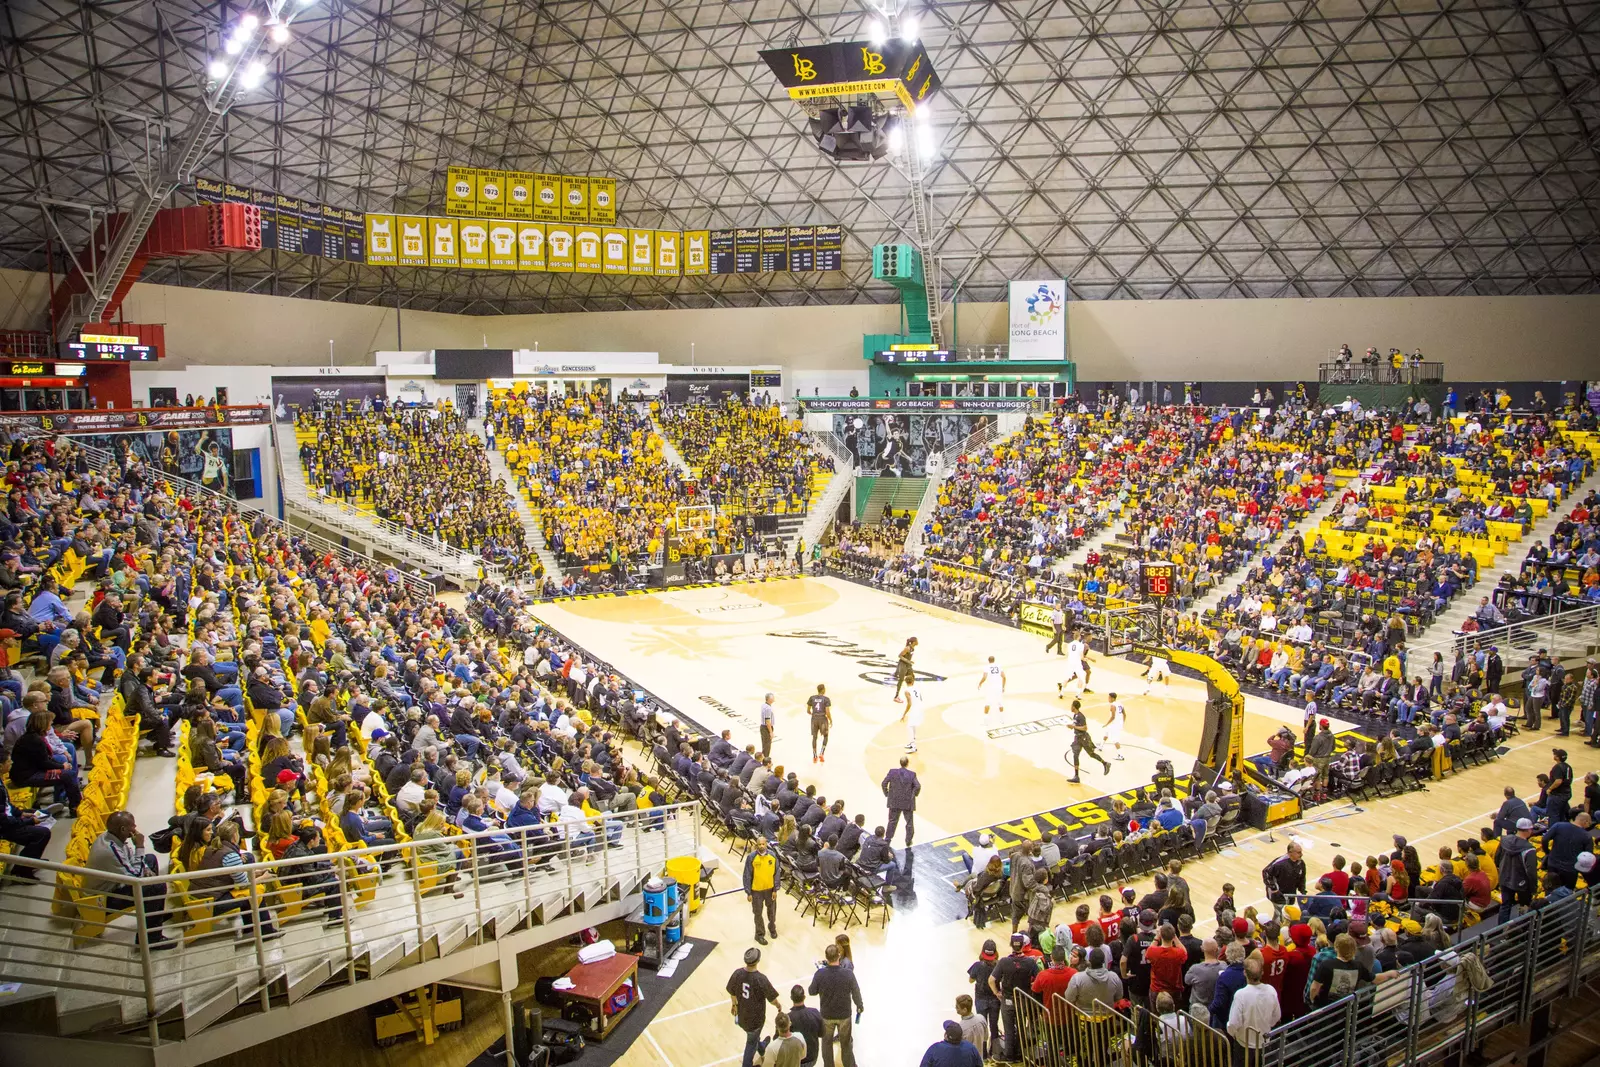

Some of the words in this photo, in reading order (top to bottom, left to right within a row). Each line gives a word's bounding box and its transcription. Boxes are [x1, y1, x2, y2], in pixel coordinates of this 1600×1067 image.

[861, 47, 886, 75] LB
[791, 53, 817, 81] LB
[448, 208, 474, 216] CHAMPIONS
[477, 210, 503, 218] CHAMPIONS
[442, 243, 447, 252] 4
[470, 239, 479, 247] 14
[529, 241, 534, 249] 2
[97, 344, 125, 353] 18:23
[78, 350, 85, 358] 3
[141, 352, 147, 360] 2
[22, 365, 43, 373] Beach
[314, 388, 340, 396] Beach
[41, 416, 53, 430] LB
[73, 415, 108, 423] CABE
[669, 546, 681, 562] LB
[1146, 567, 1171, 577] 18:23
[666, 575, 684, 583] jetBlue
[1153, 577, 1167, 593] 16
[1023, 606, 1034, 619] Go
[1072, 644, 1076, 652] 0
[990, 666, 999, 674] 23
[815, 702, 820, 711] 4
[1108, 923, 1118, 938] 13
[1269, 959, 1285, 976] 13
[742, 983, 750, 999] 5
